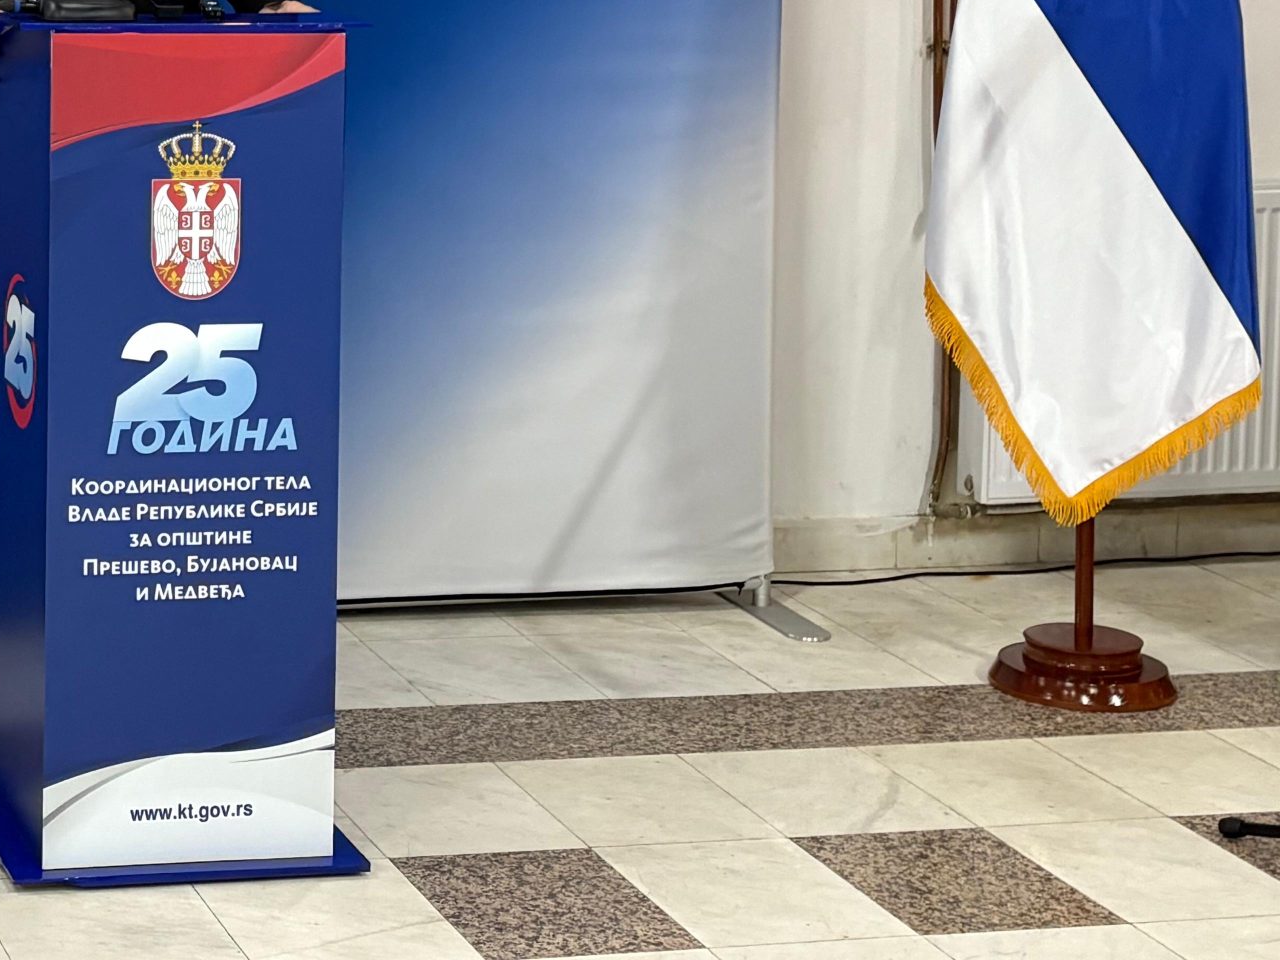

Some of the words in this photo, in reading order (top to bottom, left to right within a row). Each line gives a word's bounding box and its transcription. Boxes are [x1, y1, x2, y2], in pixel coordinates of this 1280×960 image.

[4, 293, 35, 400] 25
[112, 322, 264, 423] 25
[106, 417, 299, 455] ГОДИНА
[130, 802, 254, 823] www.kt.gov.rs
